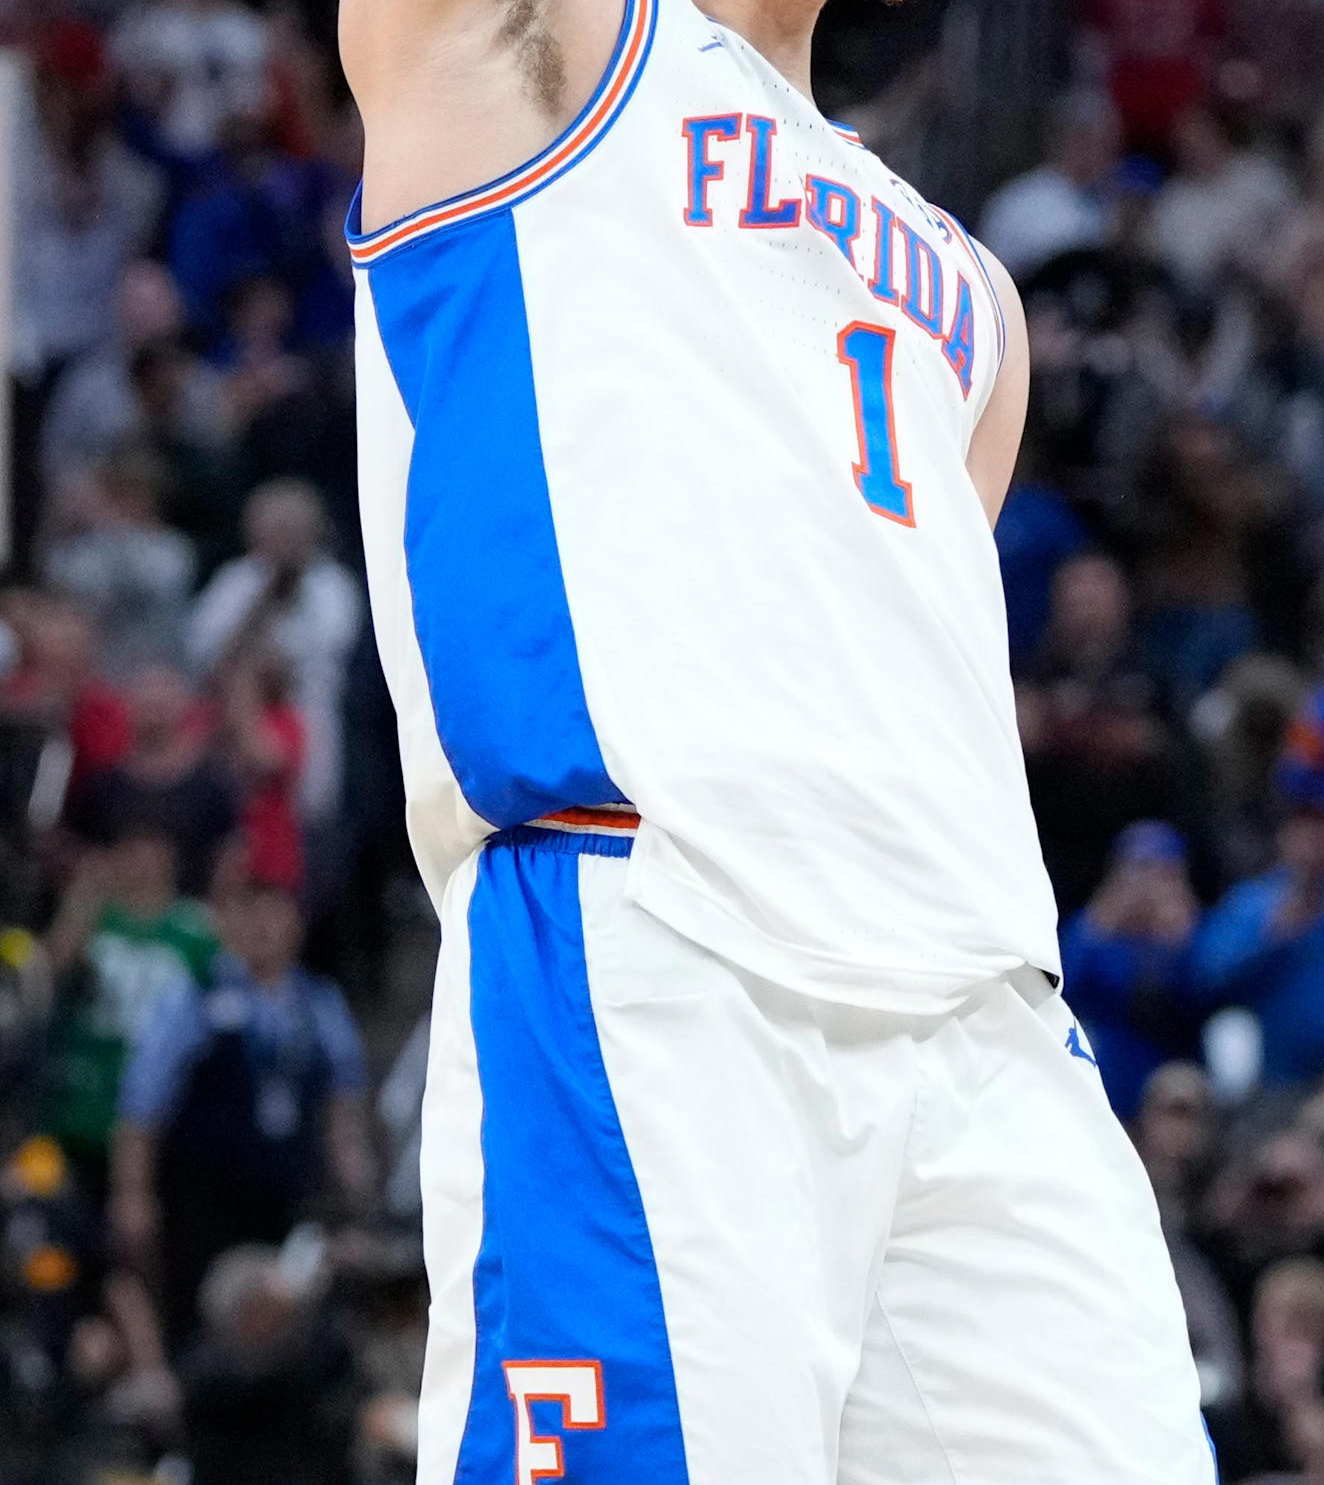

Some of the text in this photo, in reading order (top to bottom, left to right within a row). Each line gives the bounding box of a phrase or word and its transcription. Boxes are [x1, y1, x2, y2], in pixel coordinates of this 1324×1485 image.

[682, 112, 975, 401] FLRIDA
[837, 320, 916, 528] 1
[502, 1359, 606, 1485] F
